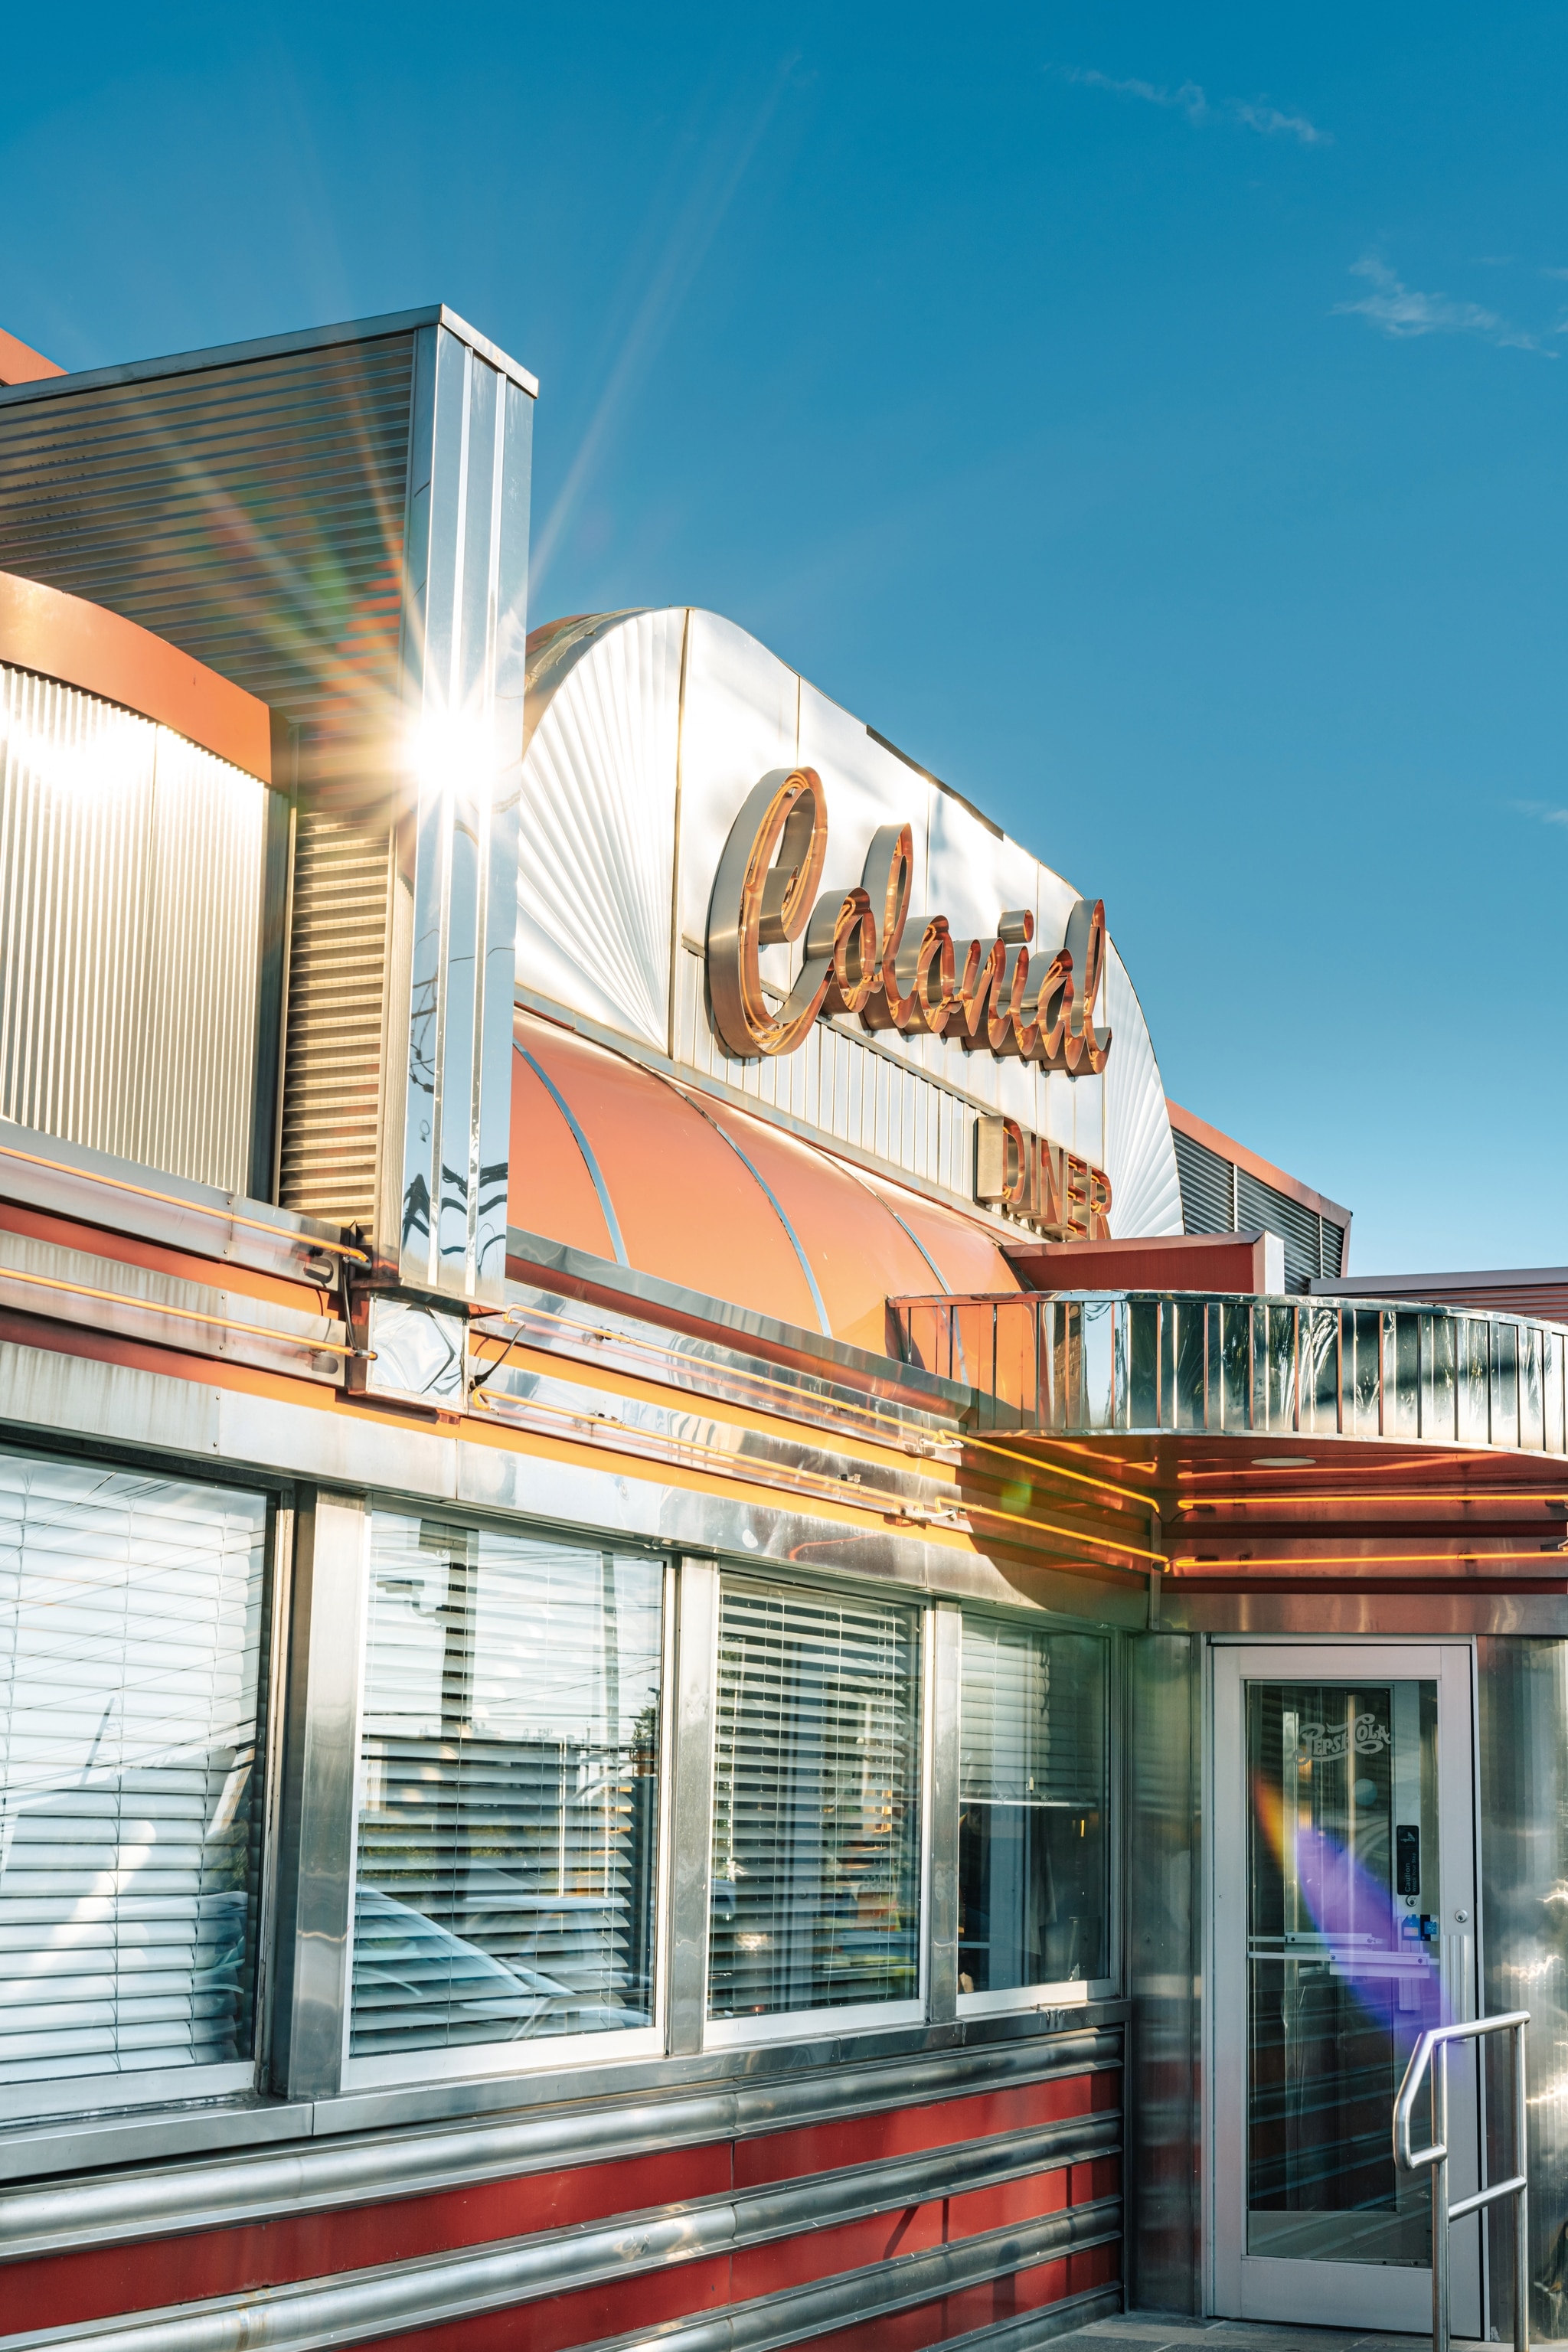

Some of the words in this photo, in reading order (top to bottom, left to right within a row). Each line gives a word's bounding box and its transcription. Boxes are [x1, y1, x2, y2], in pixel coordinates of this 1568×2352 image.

[707, 766, 1112, 1076] Colonial
[976, 1115, 1113, 1241] DINER
[1403, 1863, 1412, 1893] Caution
